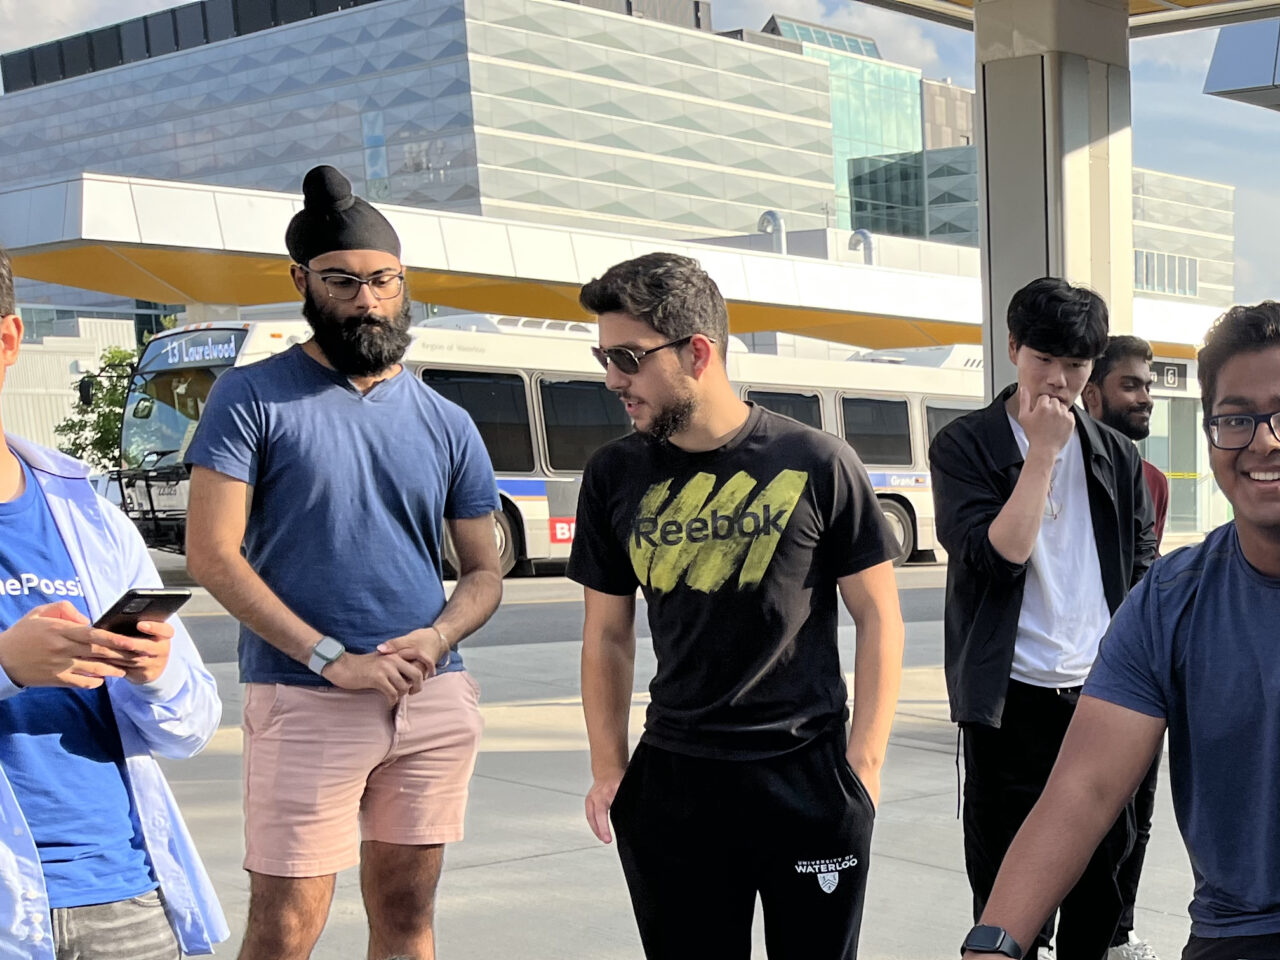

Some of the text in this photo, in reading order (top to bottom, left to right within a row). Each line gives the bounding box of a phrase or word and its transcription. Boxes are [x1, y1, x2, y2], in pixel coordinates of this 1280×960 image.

[168, 335, 236, 363] 13 Laurelwood
[1167, 369, 1175, 384] 6
[633, 504, 787, 549] Reebok
[794, 858, 858, 873] WATERLOO
[797, 857, 842, 865] UNIVERSITY
